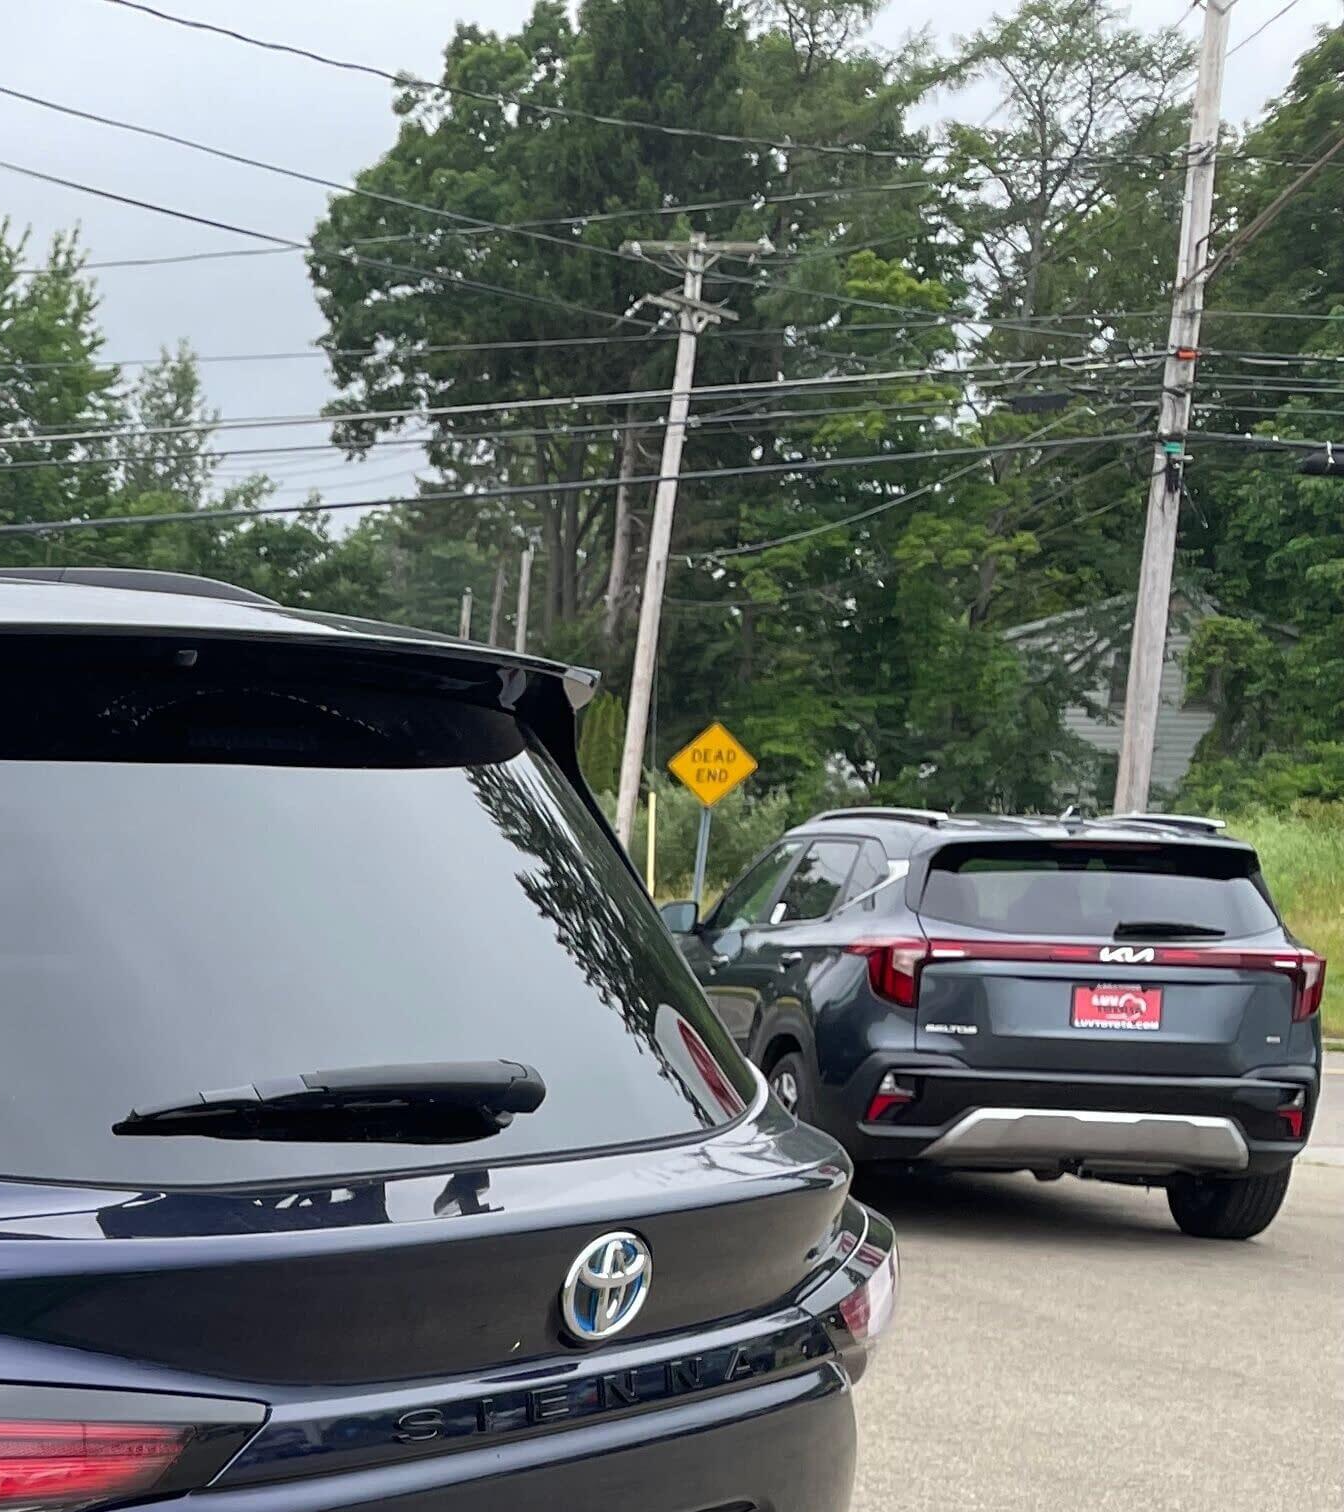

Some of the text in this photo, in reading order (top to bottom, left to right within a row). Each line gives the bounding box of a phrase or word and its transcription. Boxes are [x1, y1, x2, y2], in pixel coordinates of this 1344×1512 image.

[692, 748, 736, 763] DEAD
[695, 768, 729, 783] END
[392, 1346, 754, 1442] SIENNA
